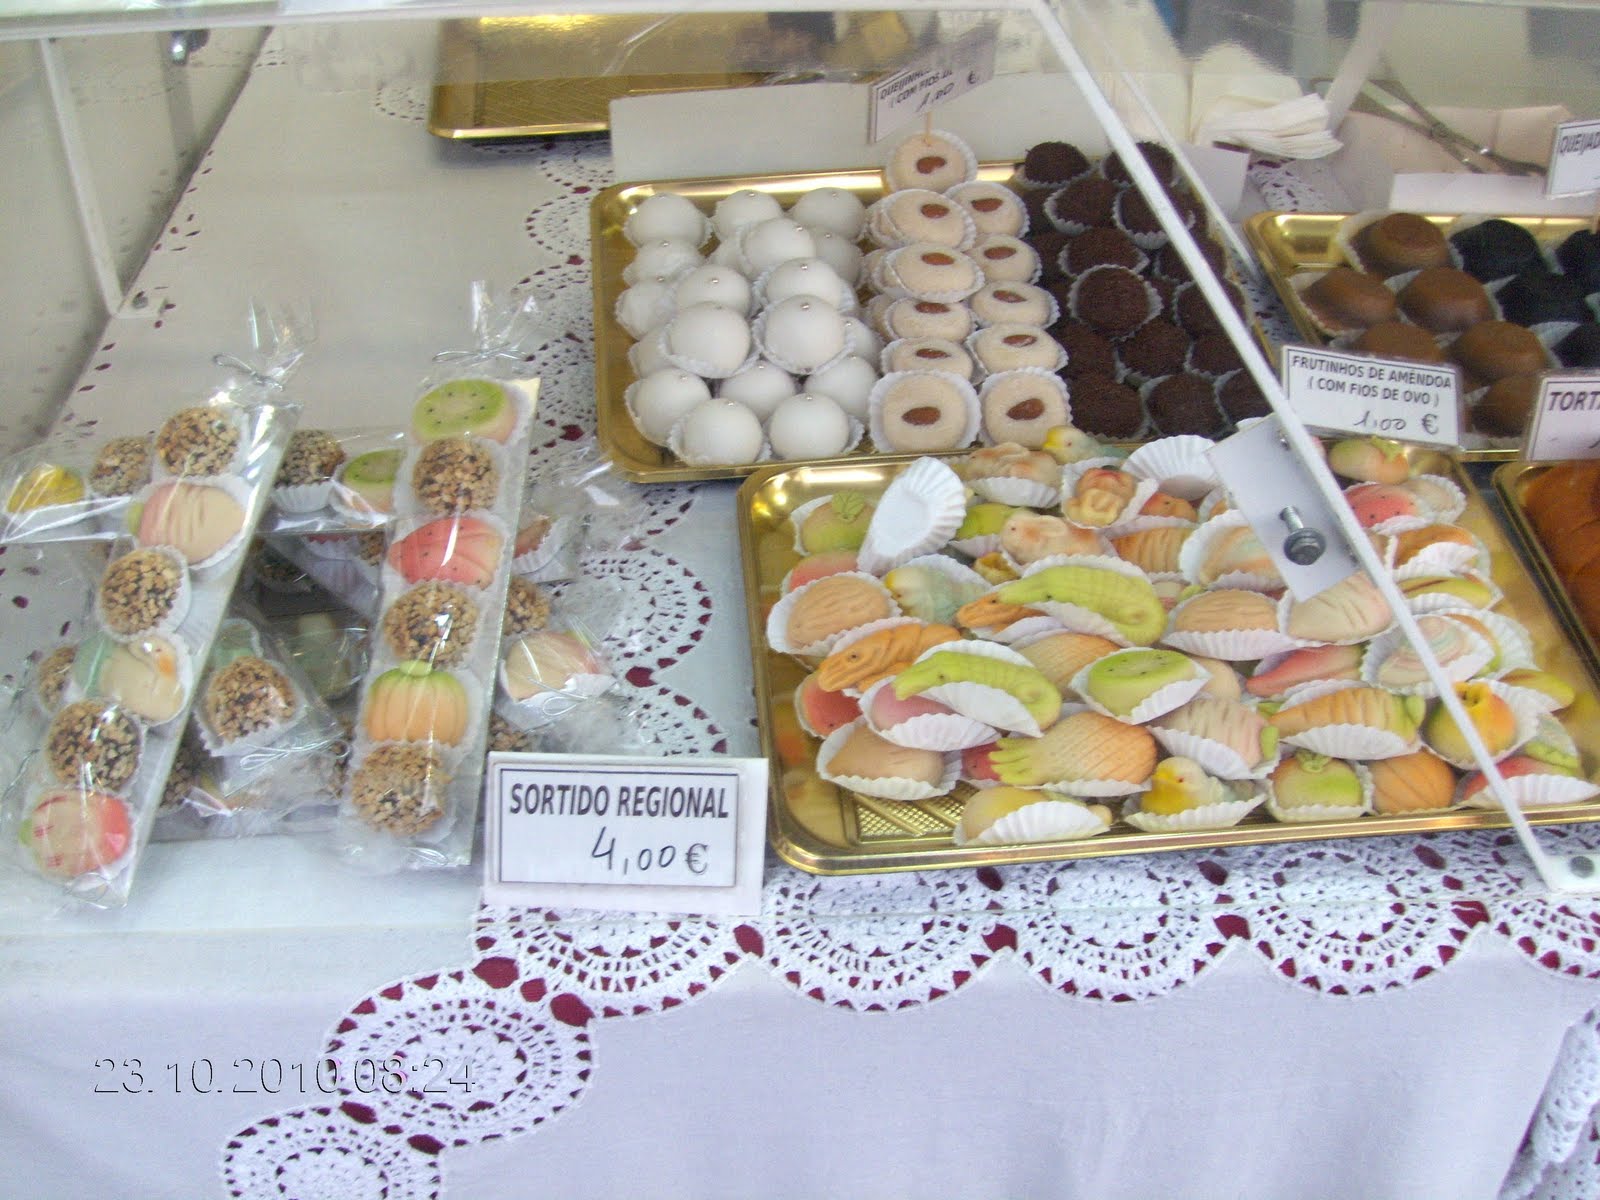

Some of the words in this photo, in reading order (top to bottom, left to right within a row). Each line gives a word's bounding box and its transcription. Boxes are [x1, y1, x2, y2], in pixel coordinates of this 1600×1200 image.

[1292, 355, 1364, 378] FRUTINHOS
[1369, 366, 1385, 381] DE
[1388, 368, 1451, 388] AMÊNDOA
[1350, 383, 1379, 398] FIOS
[1382, 387, 1399, 401] DE
[1548, 391, 1600, 411] TORT
[1353, 410, 1407, 431] 1,00
[1420, 413, 1439, 435] €
[510, 783, 610, 816] SORTIDO
[616, 786, 729, 819] REGIONAL
